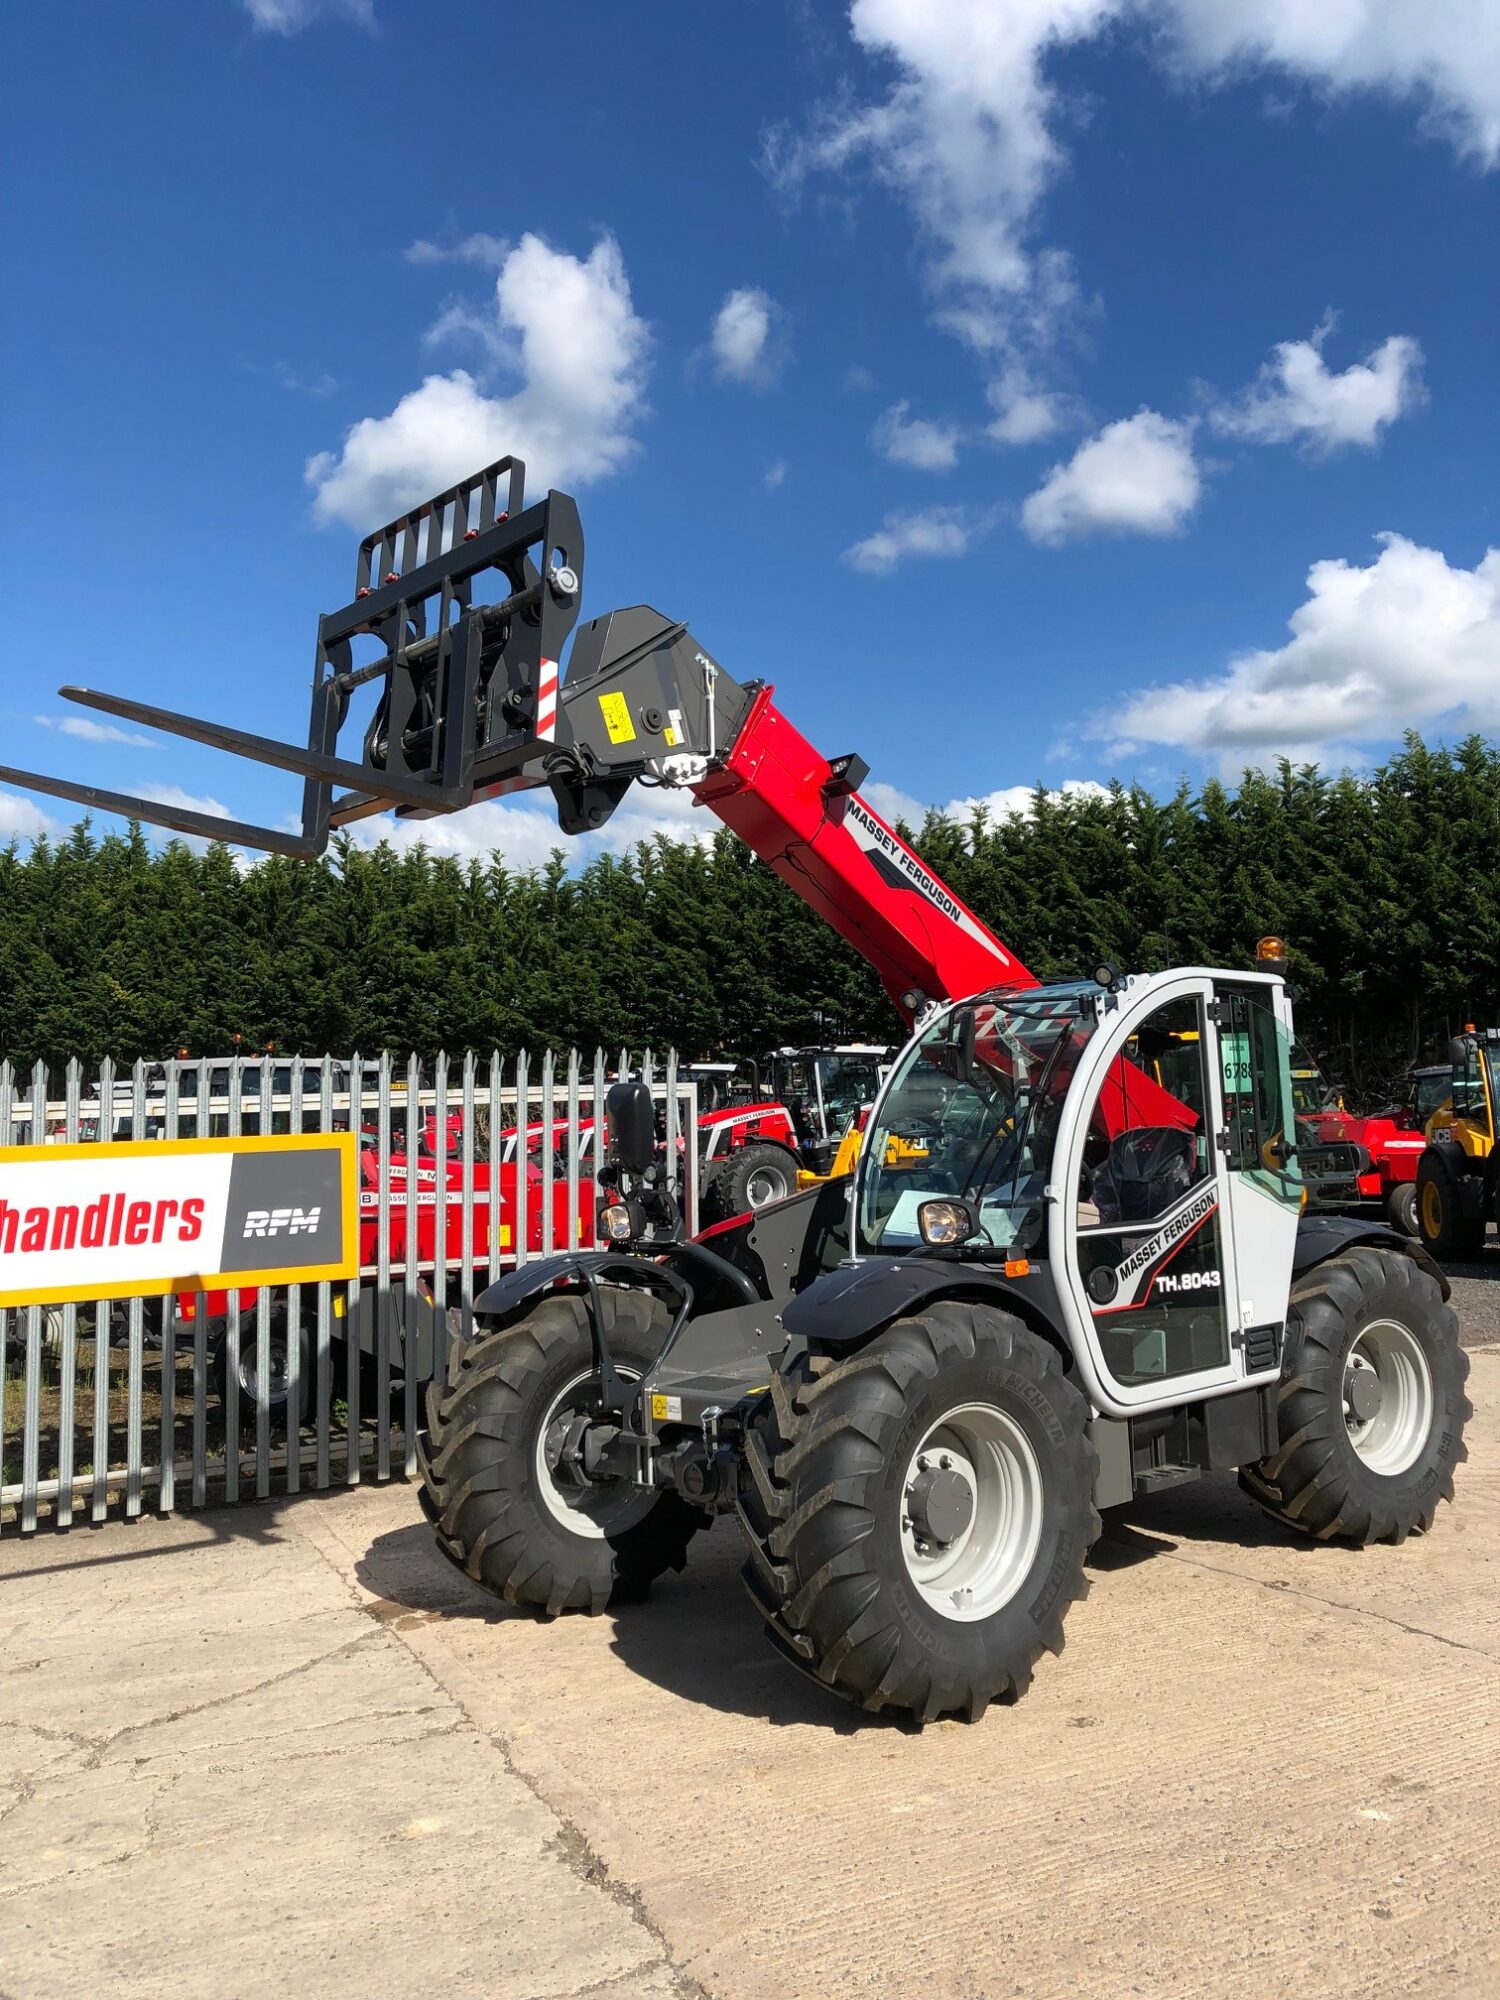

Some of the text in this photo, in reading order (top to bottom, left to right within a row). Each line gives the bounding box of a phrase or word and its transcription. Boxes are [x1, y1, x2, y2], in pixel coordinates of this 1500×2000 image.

[847, 800, 962, 922] MASSEY FERGUSON
[1432, 1129, 1451, 1144] JCB
[0, 1193, 205, 1253] handlers
[243, 1207, 322, 1238] RFM
[1119, 1192, 1216, 1281] MASSEY FERGUSON
[1156, 1270, 1221, 1293] TH.8043
[1005, 1371, 1066, 1443] MICHELIN
